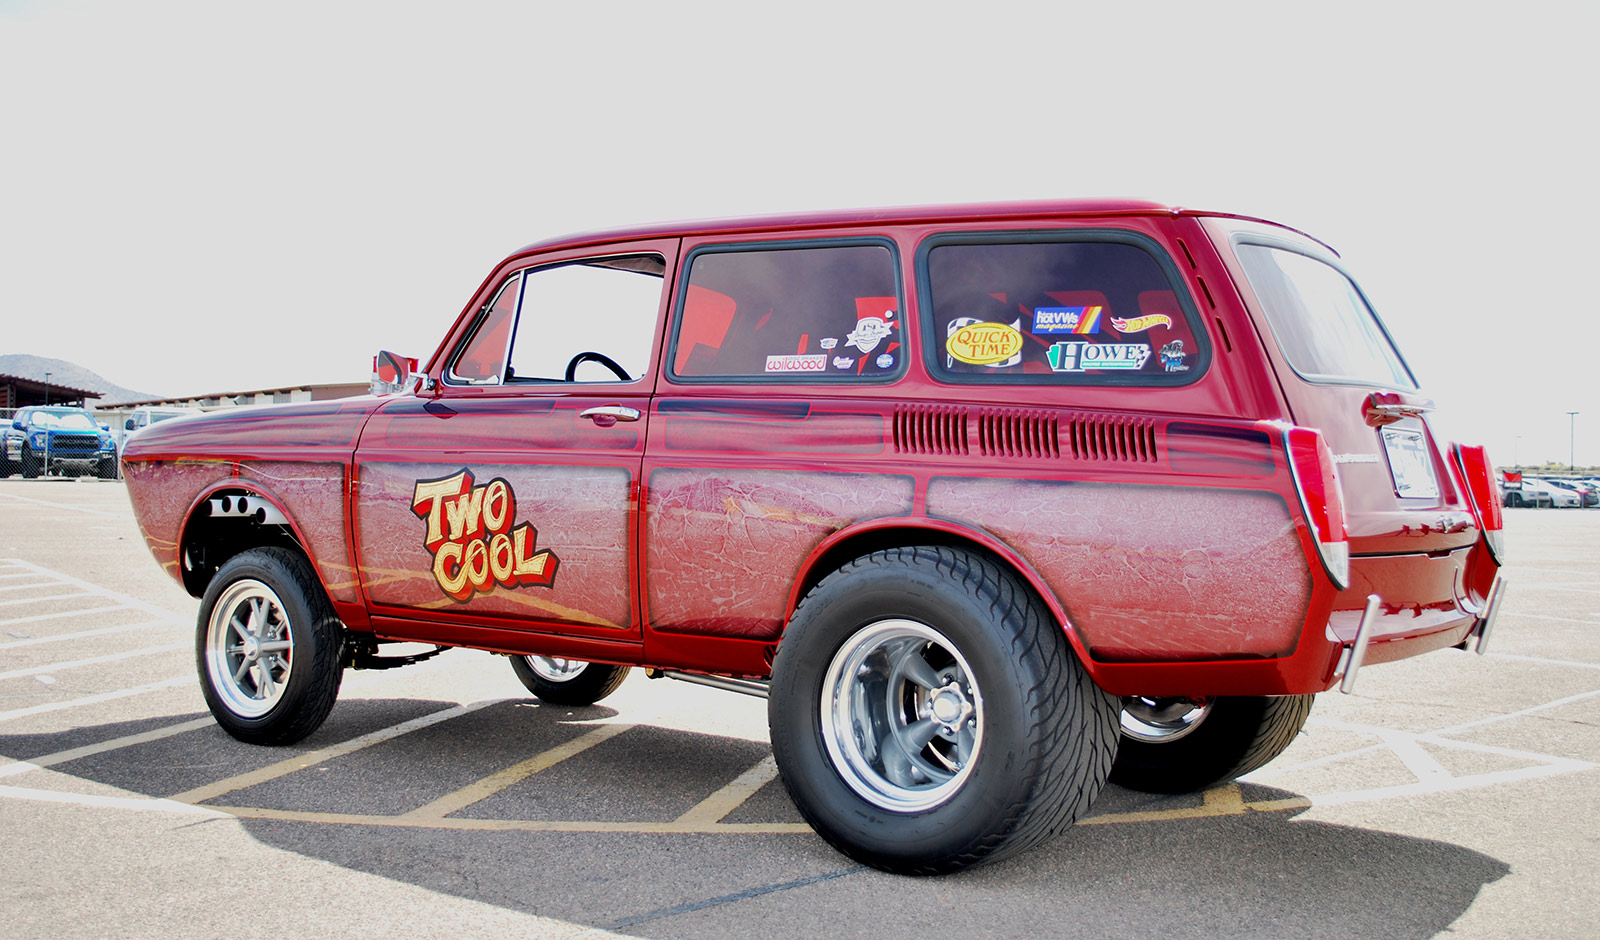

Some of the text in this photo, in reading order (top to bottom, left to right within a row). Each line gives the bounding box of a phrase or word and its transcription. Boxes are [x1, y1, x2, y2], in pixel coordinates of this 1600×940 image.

[1035, 324, 1078, 332] magazine
[957, 330, 1012, 345] QUICK
[968, 343, 1011, 358] TIME
[1056, 343, 1136, 370] HOWE
[767, 356, 826, 370] wilwood
[411, 468, 512, 547] TWO
[432, 523, 555, 599] COOL
